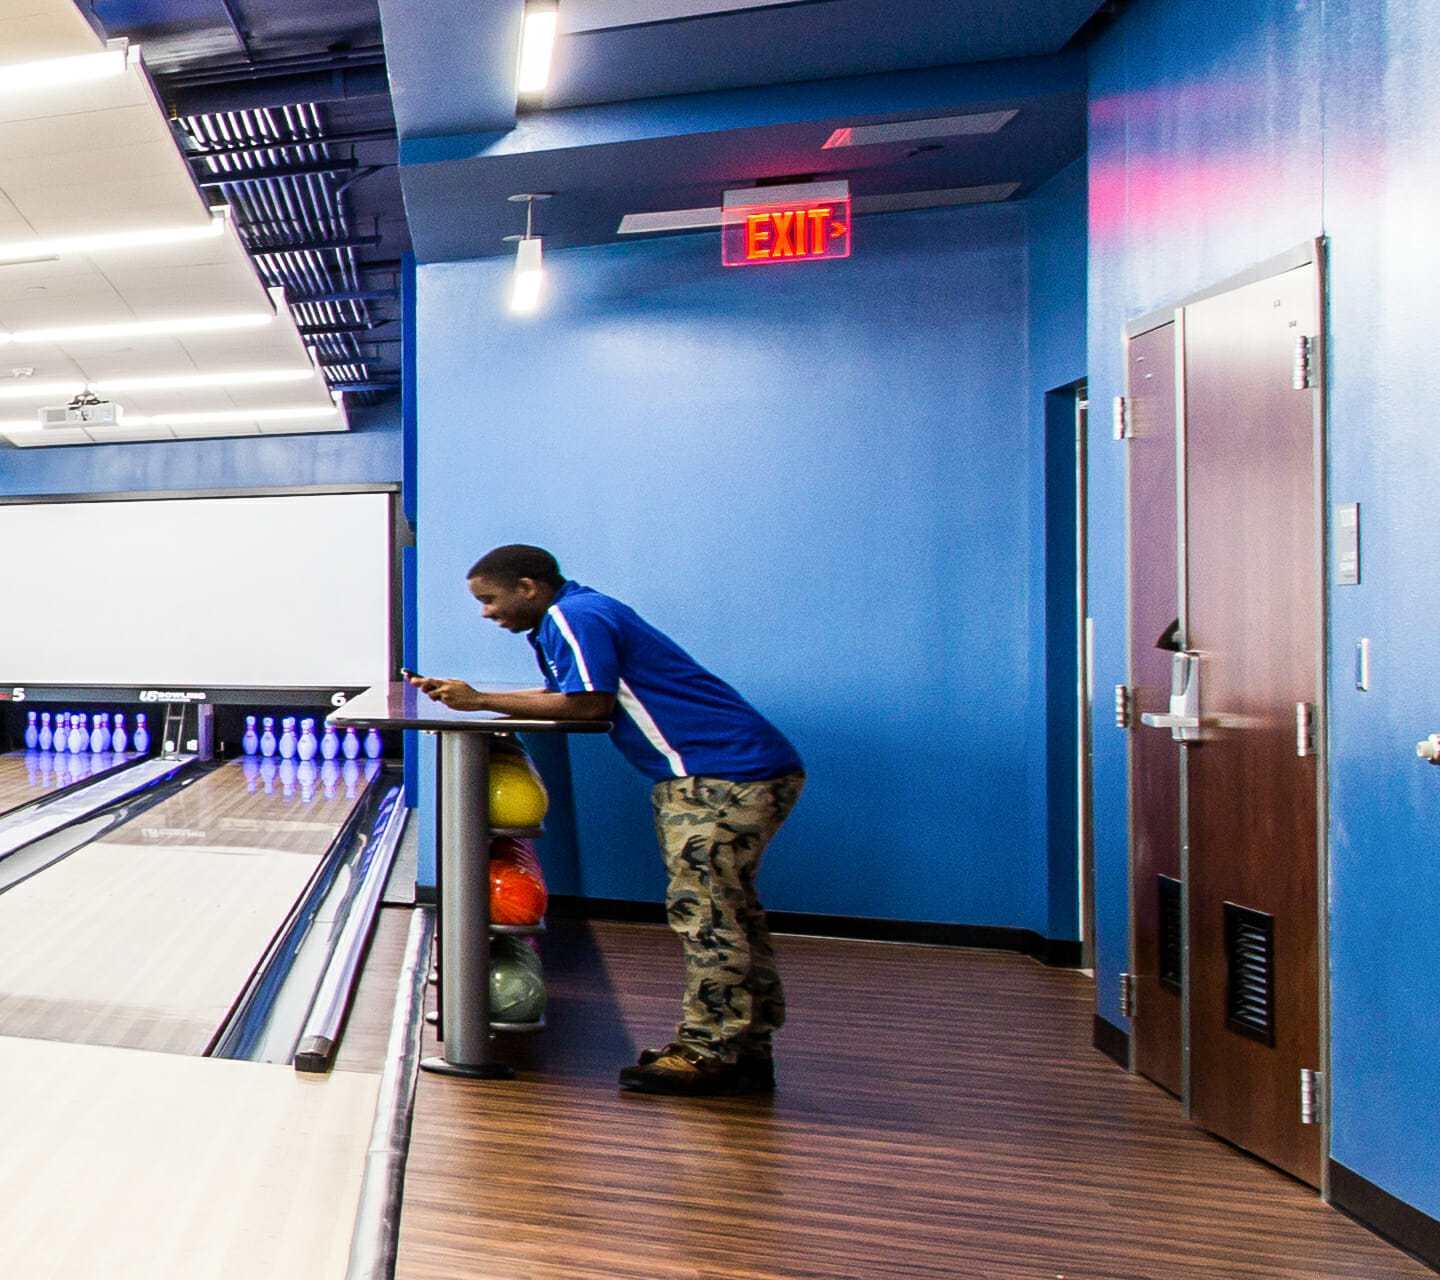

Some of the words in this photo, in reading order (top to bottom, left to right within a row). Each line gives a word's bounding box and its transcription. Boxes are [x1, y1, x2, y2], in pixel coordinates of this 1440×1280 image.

[746, 208, 832, 260] EXIT
[12, 687, 25, 702] 5
[331, 692, 347, 707] 6
